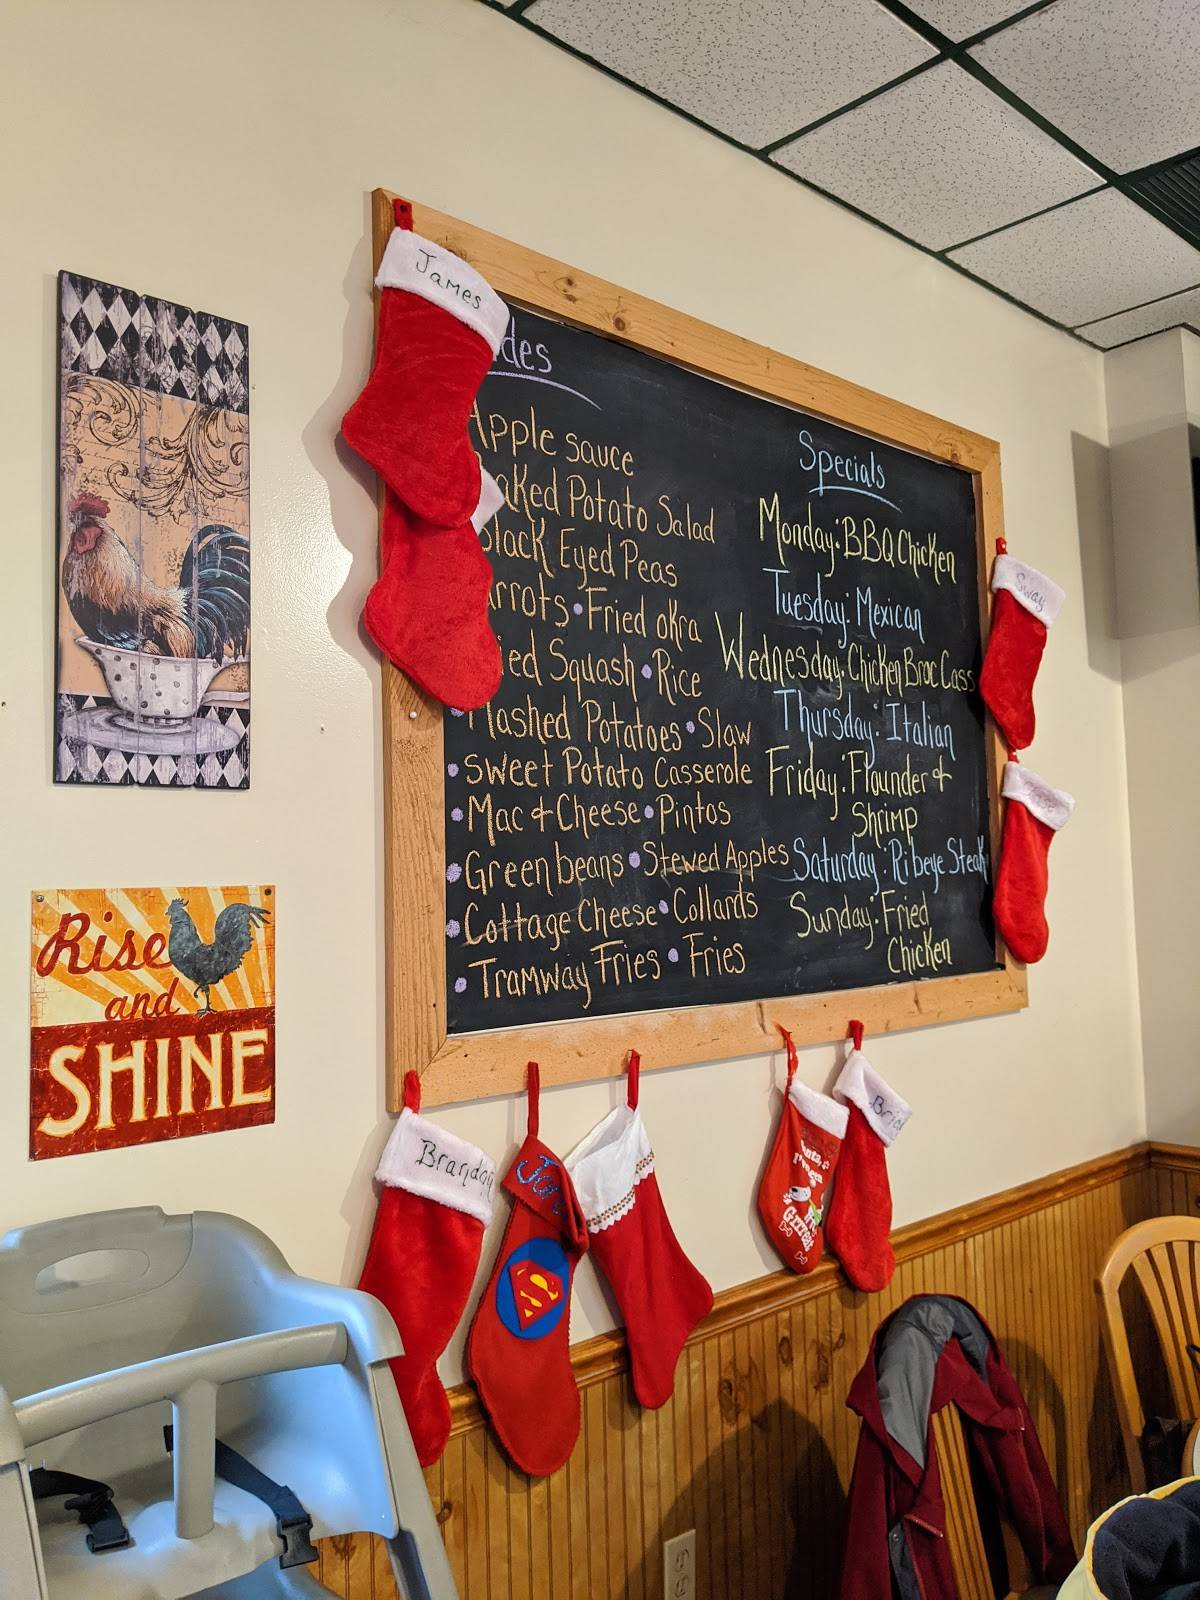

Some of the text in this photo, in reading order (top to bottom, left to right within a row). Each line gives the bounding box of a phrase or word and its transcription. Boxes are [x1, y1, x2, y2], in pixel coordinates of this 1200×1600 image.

[415, 249, 483, 311] James
[493, 317, 553, 374] des
[799, 430, 886, 497] Specials
[490, 463, 716, 544] aked Potato Salad
[559, 527, 616, 590] Eyed
[619, 538, 678, 588] Peas
[842, 516, 896, 568] BBQ
[897, 529, 957, 585] Chicken
[585, 586, 647, 638] Fried
[762, 568, 926, 649] Tuesday: Mexican
[1016, 572, 1046, 613] Sway
[550, 637, 638, 702] Squash
[652, 647, 703, 706] Rice
[847, 642, 903, 697] Chicken
[940, 650, 977, 693] Cass
[581, 699, 683, 752] Potatoes
[697, 706, 752, 749] Slaw
[773, 688, 957, 770] Thursday: Italian
[562, 745, 644, 790] Potato
[654, 745, 754, 789] Casserole
[765, 745, 848, 822] Friday:
[847, 749, 929, 799] Flounder
[467, 793, 524, 847] Mac
[556, 793, 641, 839] Cheese
[655, 791, 732, 835] Pintos
[851, 801, 919, 849] Shrimp
[642, 840, 721, 882] Stewed
[725, 837, 790, 883] Apples
[792, 834, 990, 896] Saturday: Ribeye Steak
[36, 911, 173, 978] Rise
[464, 880, 759, 951] Cottage Cheese Collards
[788, 889, 930, 951] Sunday: Fried
[467, 931, 746, 1010] Tramway Fries Fries
[886, 927, 953, 976] Chicken
[104, 976, 180, 1021] and
[36, 1028, 273, 1138] SHINE
